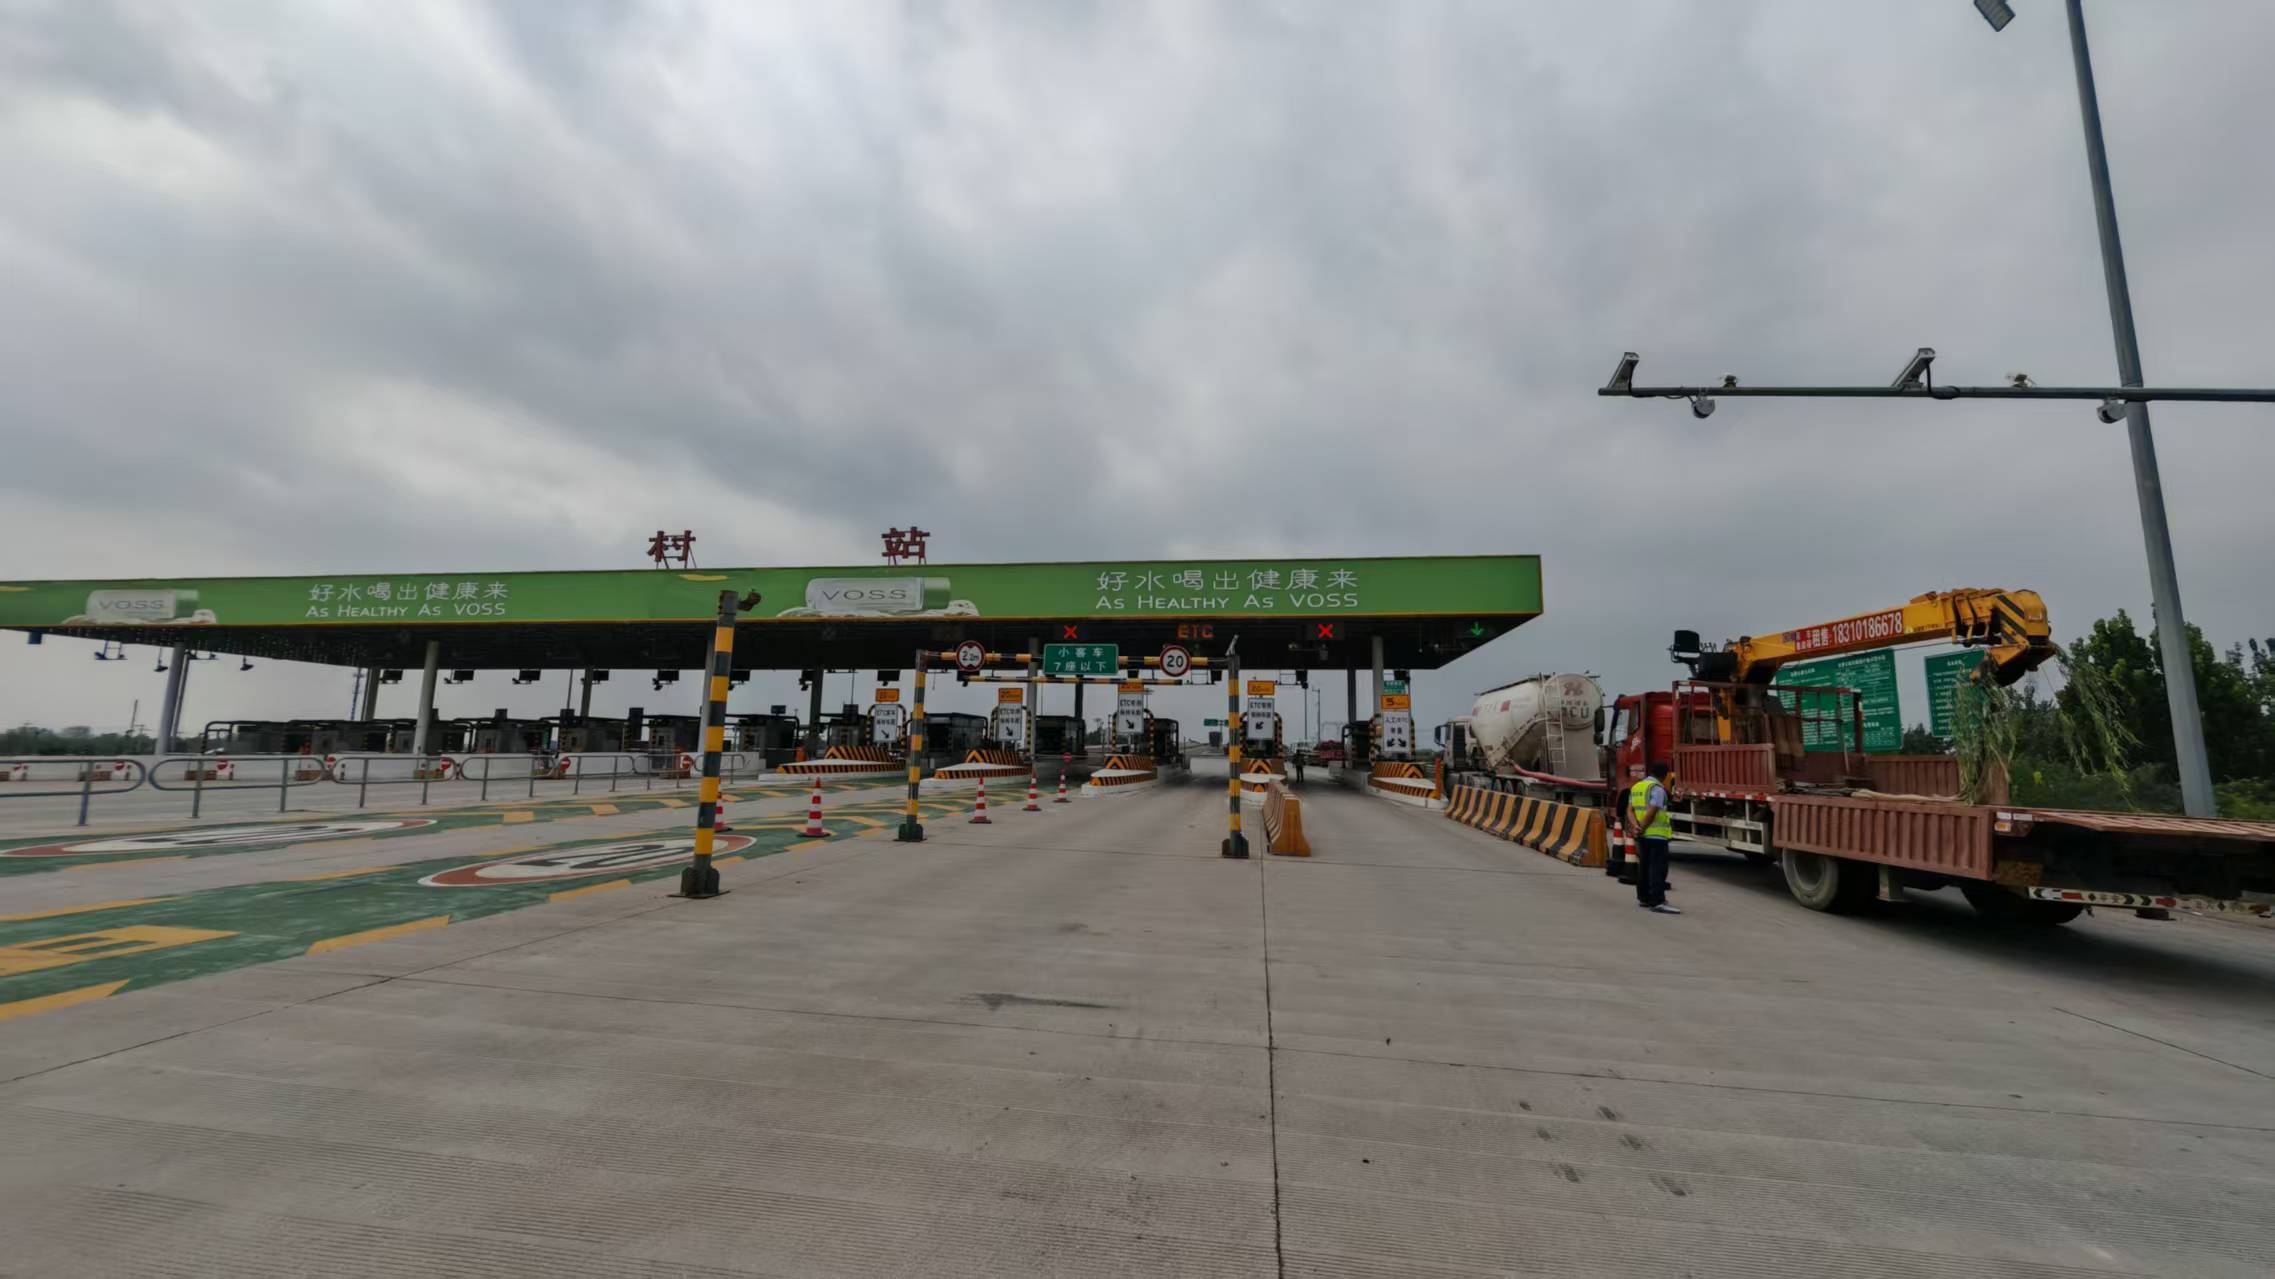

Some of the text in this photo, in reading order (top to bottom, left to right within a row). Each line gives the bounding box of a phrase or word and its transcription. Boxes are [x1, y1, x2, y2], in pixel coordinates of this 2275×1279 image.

[647, 526, 931, 562] 村 站
[1096, 569, 1359, 591] 好水喝出健康来
[308, 581, 509, 602] 好水喝出健康来
[822, 589, 908, 600] VOSS
[96, 599, 166, 610] VOSS
[1290, 593, 1359, 608] VOSS
[454, 602, 506, 616] VOSS
[1176, 624, 1216, 640] ETC
[1833, 611, 1903, 645] 18310186678
[1058, 647, 1105, 658] 小客车
[1054, 661, 1107, 672] 7座以下
[1166, 654, 1184, 668] 20
